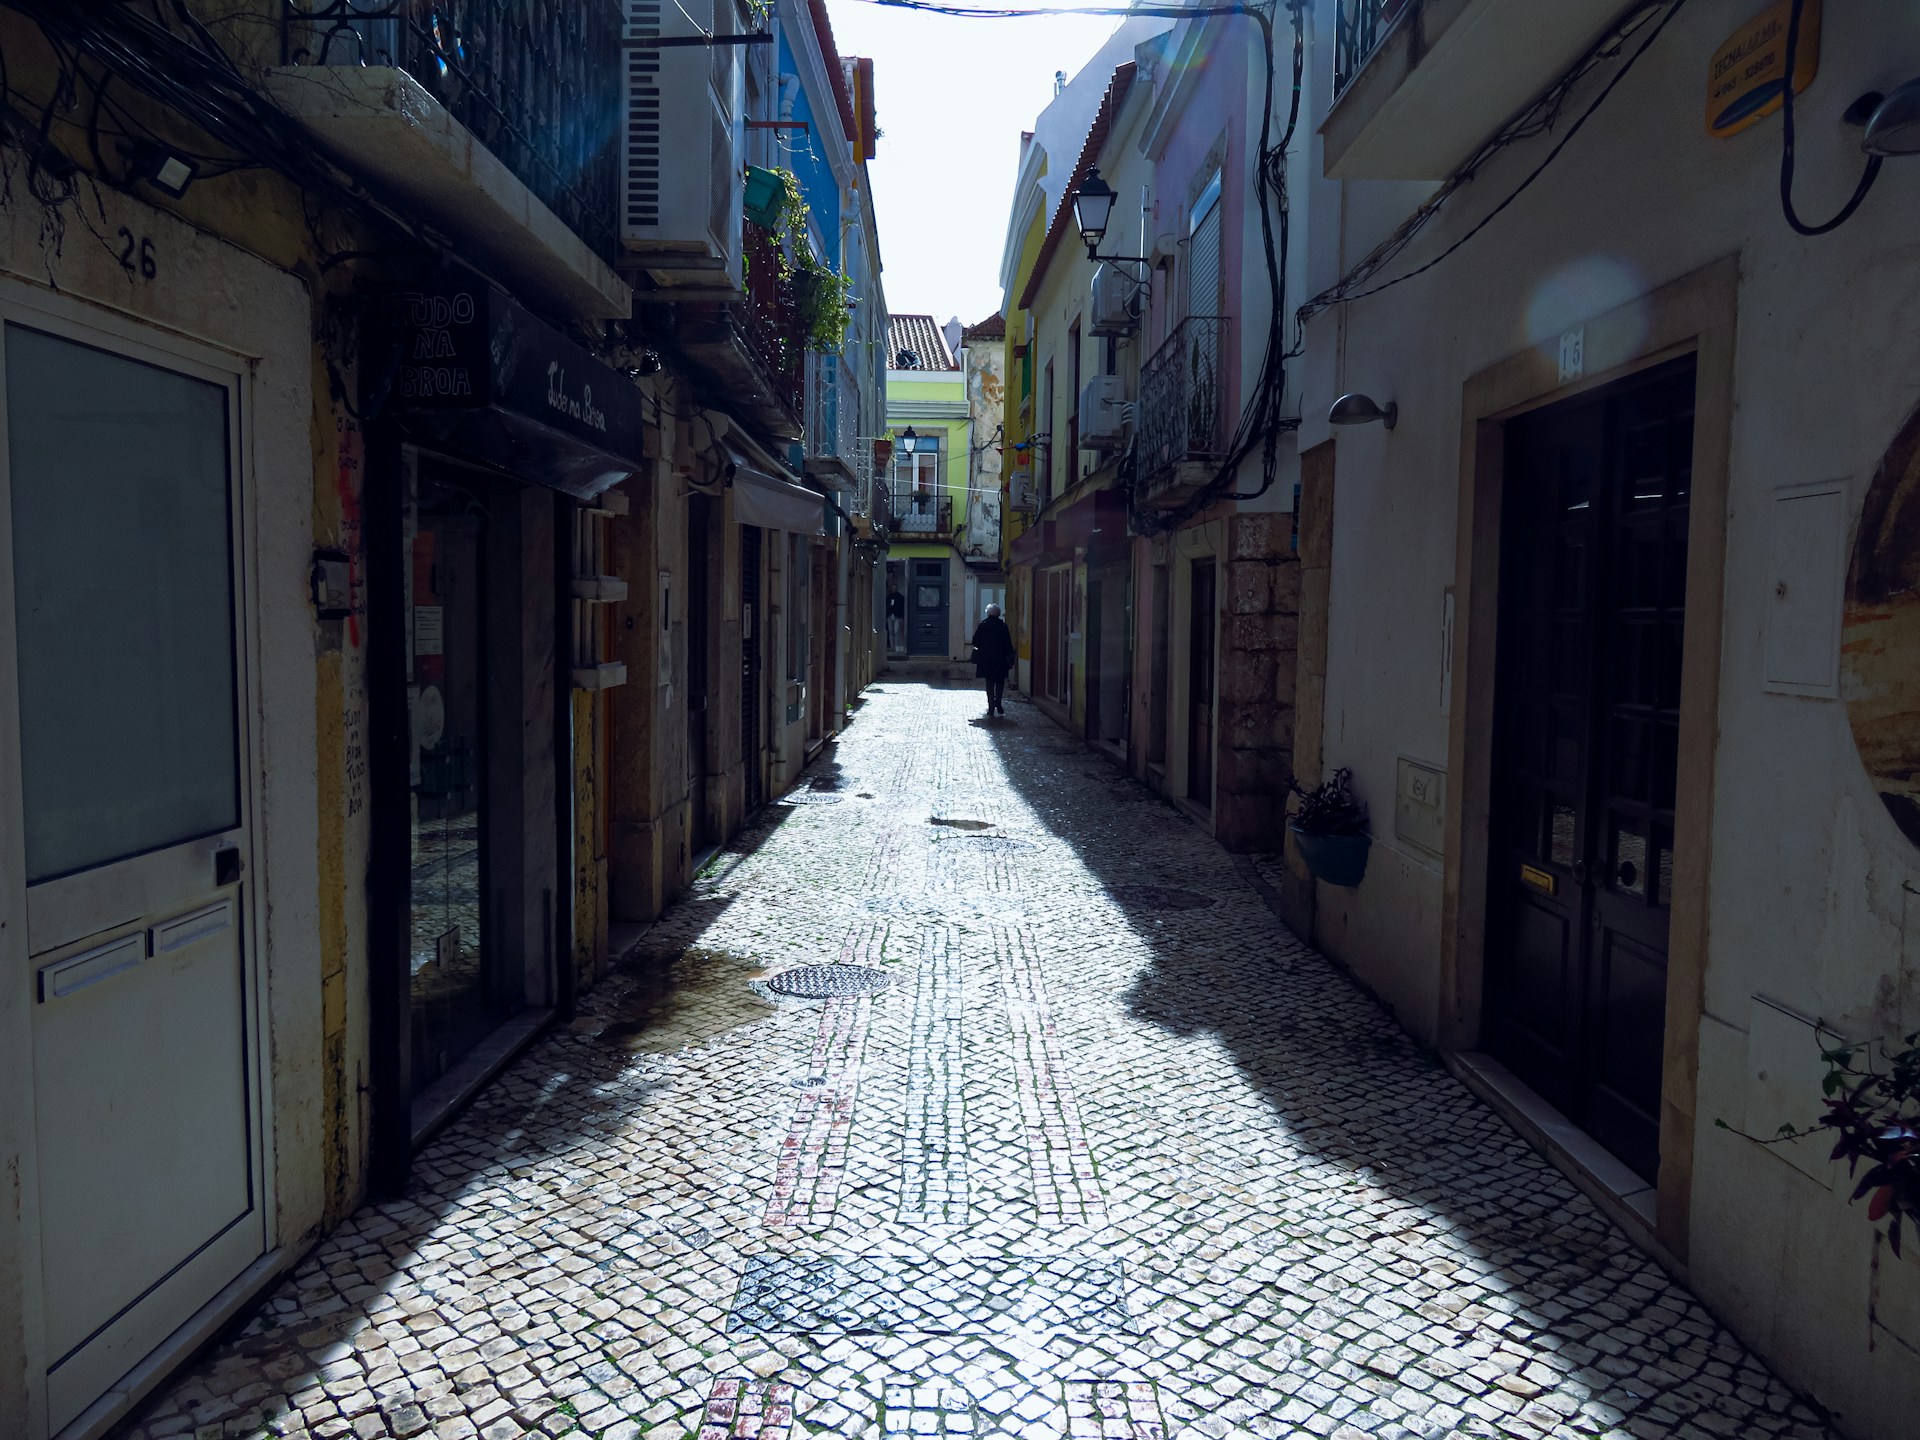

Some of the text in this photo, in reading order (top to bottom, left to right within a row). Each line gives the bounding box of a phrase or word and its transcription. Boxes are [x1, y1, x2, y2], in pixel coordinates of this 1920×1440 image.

[118, 226, 157, 280] 26
[382, 292, 475, 328] TUDO
[413, 328, 456, 359] NA
[1562, 341, 1581, 370] 15
[400, 365, 472, 397] BROA
[547, 360, 568, 413] Tudo
[569, 399, 582, 420] na
[583, 384, 607, 432] Broa
